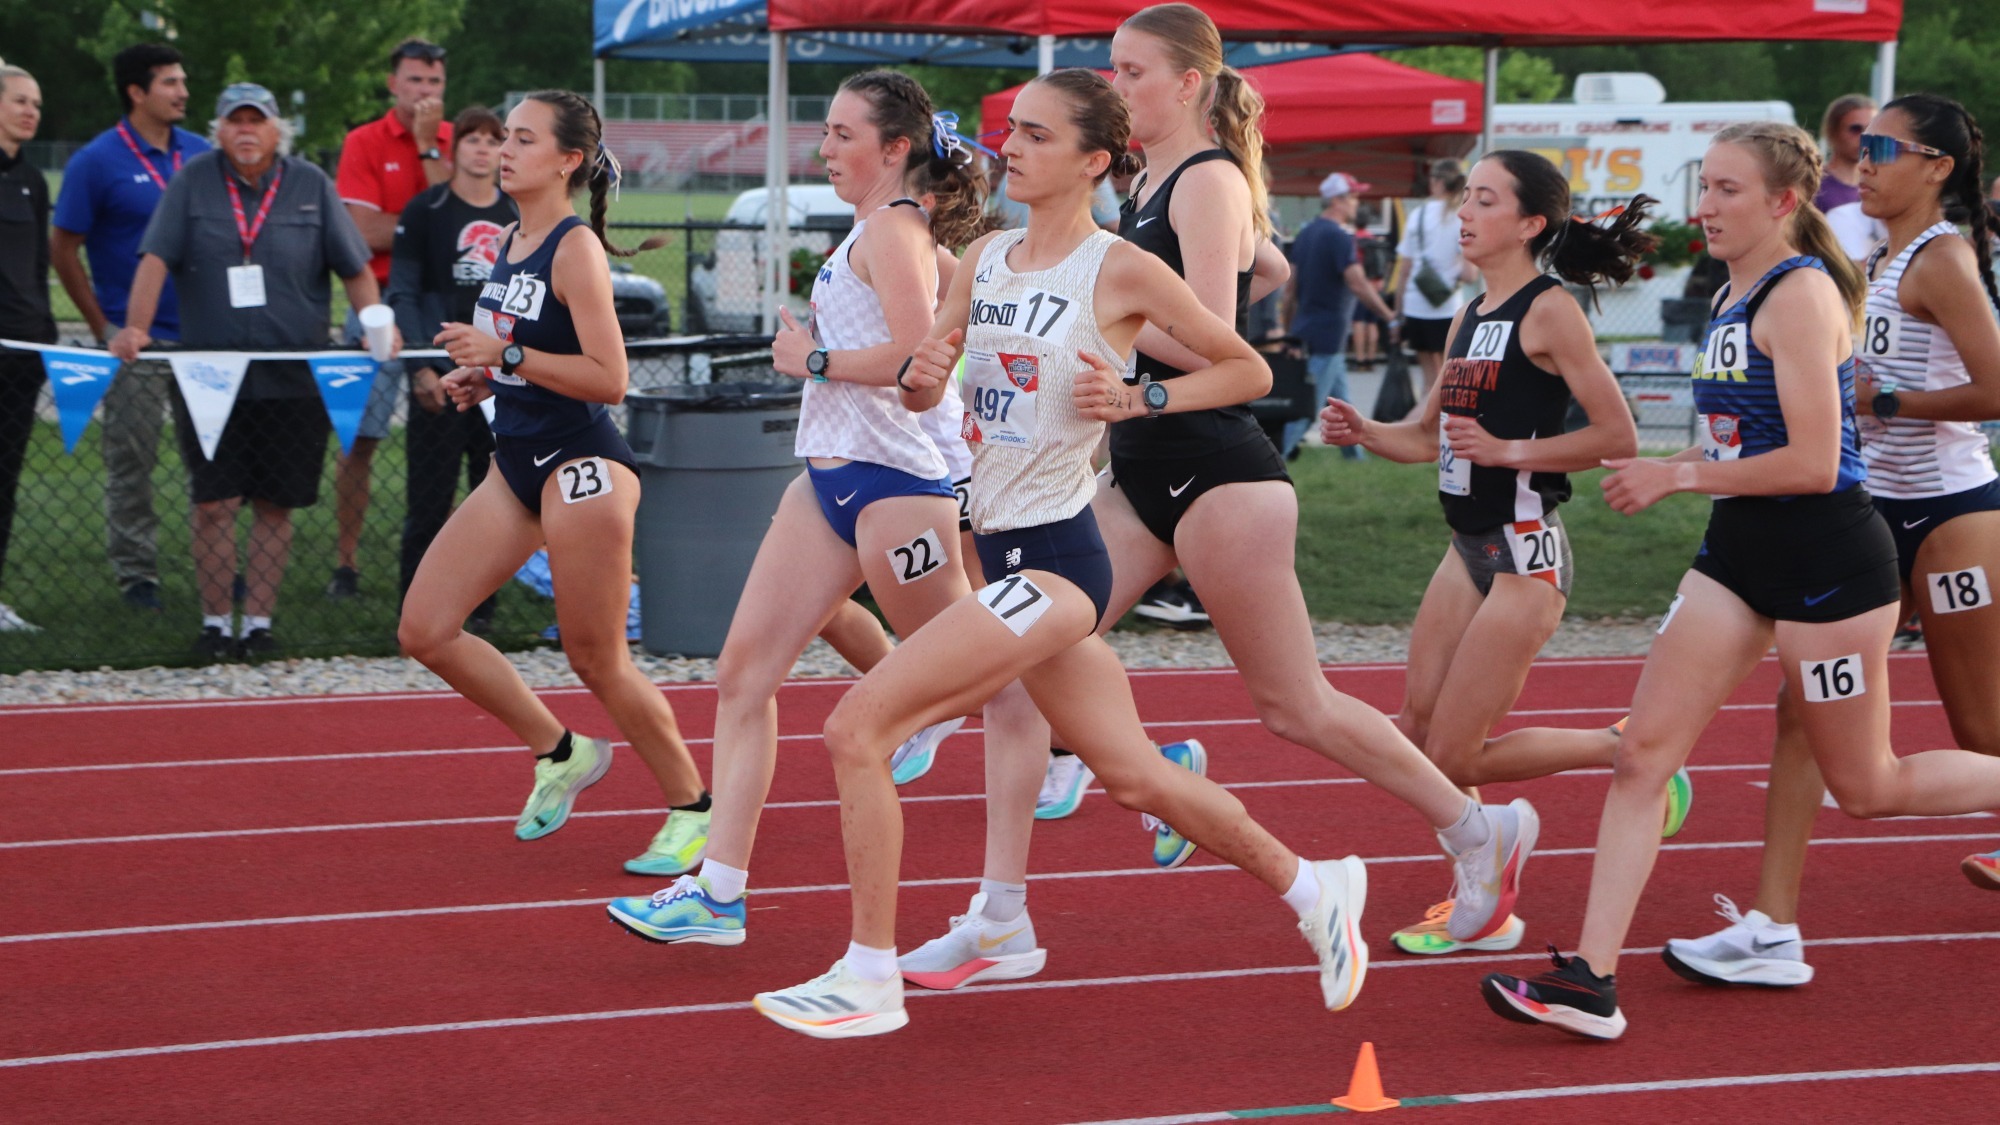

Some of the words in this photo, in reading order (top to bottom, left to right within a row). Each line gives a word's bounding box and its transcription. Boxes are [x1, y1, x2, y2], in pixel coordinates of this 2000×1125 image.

[505, 277, 537, 314] 23
[1024, 292, 1069, 338] 17
[1471, 323, 1504, 357] 20
[1711, 326, 1737, 369] 16
[1863, 315, 1890, 355] 18
[974, 387, 1016, 422] 497
[1000, 433, 1027, 443] BROOKS
[563, 460, 602, 501] 23
[954, 487, 970, 517] 2
[894, 538, 938, 580] 22
[1523, 531, 1556, 570] 20
[989, 576, 1042, 619] 17
[1936, 571, 1980, 609] 18
[1812, 658, 1854, 699] 16
